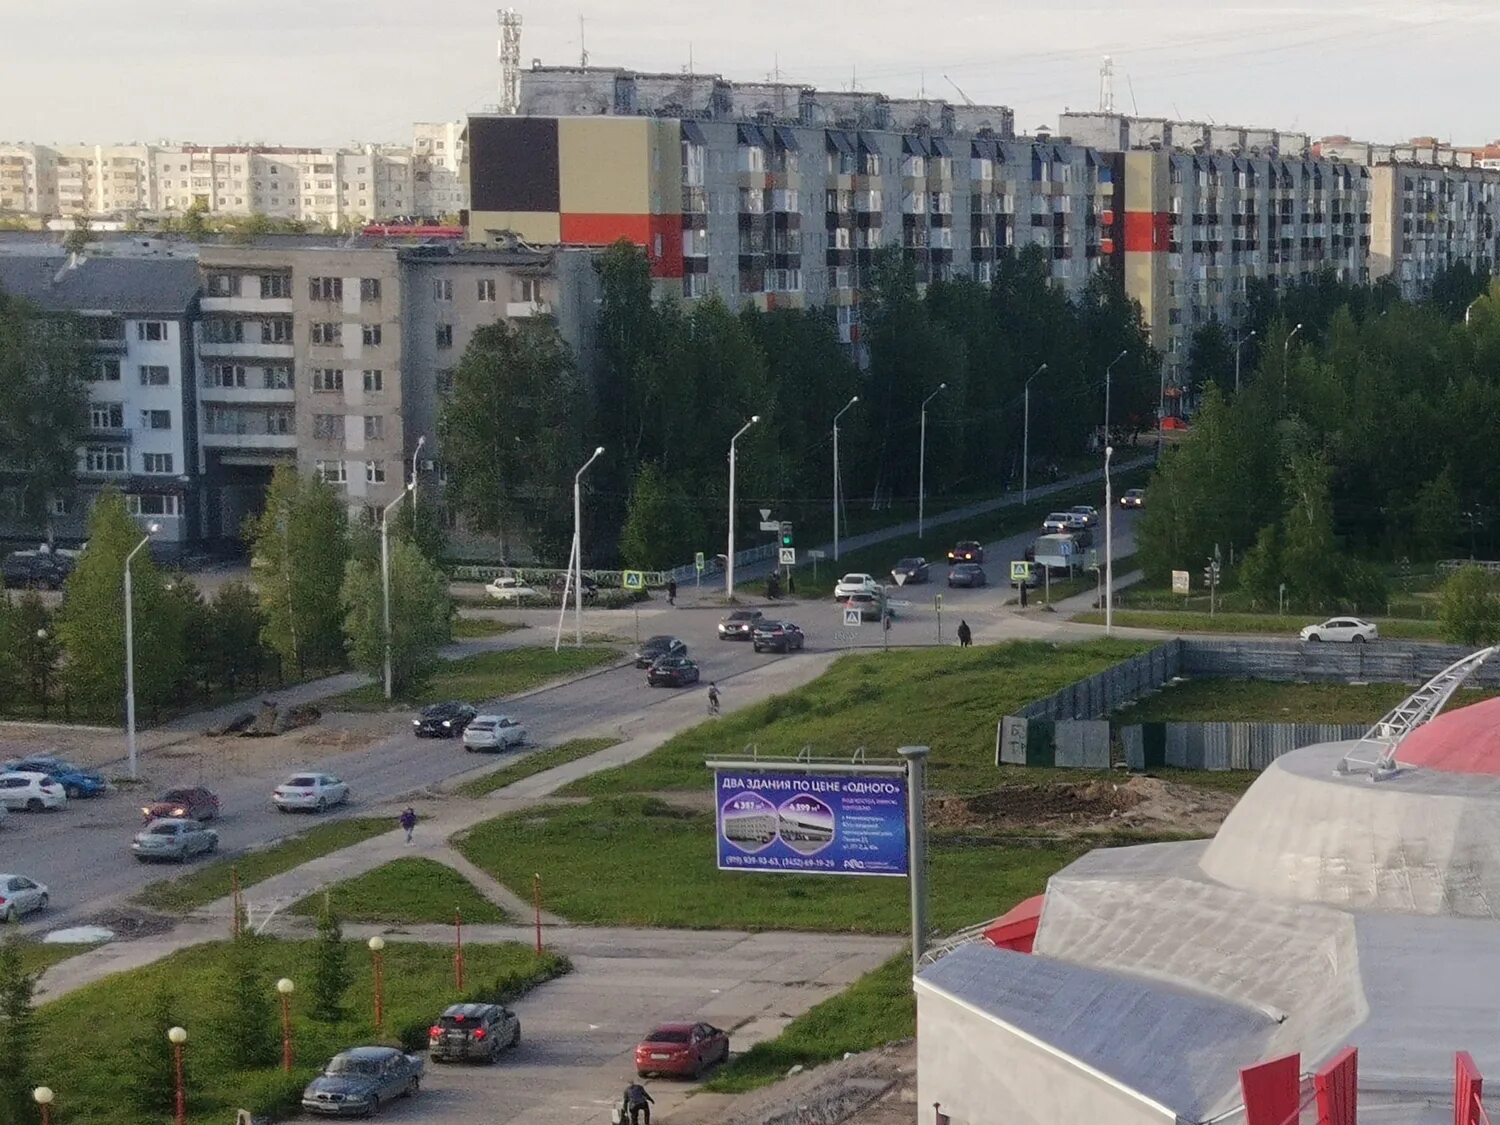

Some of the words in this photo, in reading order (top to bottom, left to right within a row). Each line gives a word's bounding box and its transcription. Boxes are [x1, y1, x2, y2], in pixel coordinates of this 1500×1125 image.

[722, 778, 745, 790] ДВА
[746, 779, 791, 790] ЗДАНИЯ
[793, 780, 809, 791] ПО
[811, 781, 840, 793] ЦЕНЕ
[842, 782, 900, 794] «ОДНОГО»
